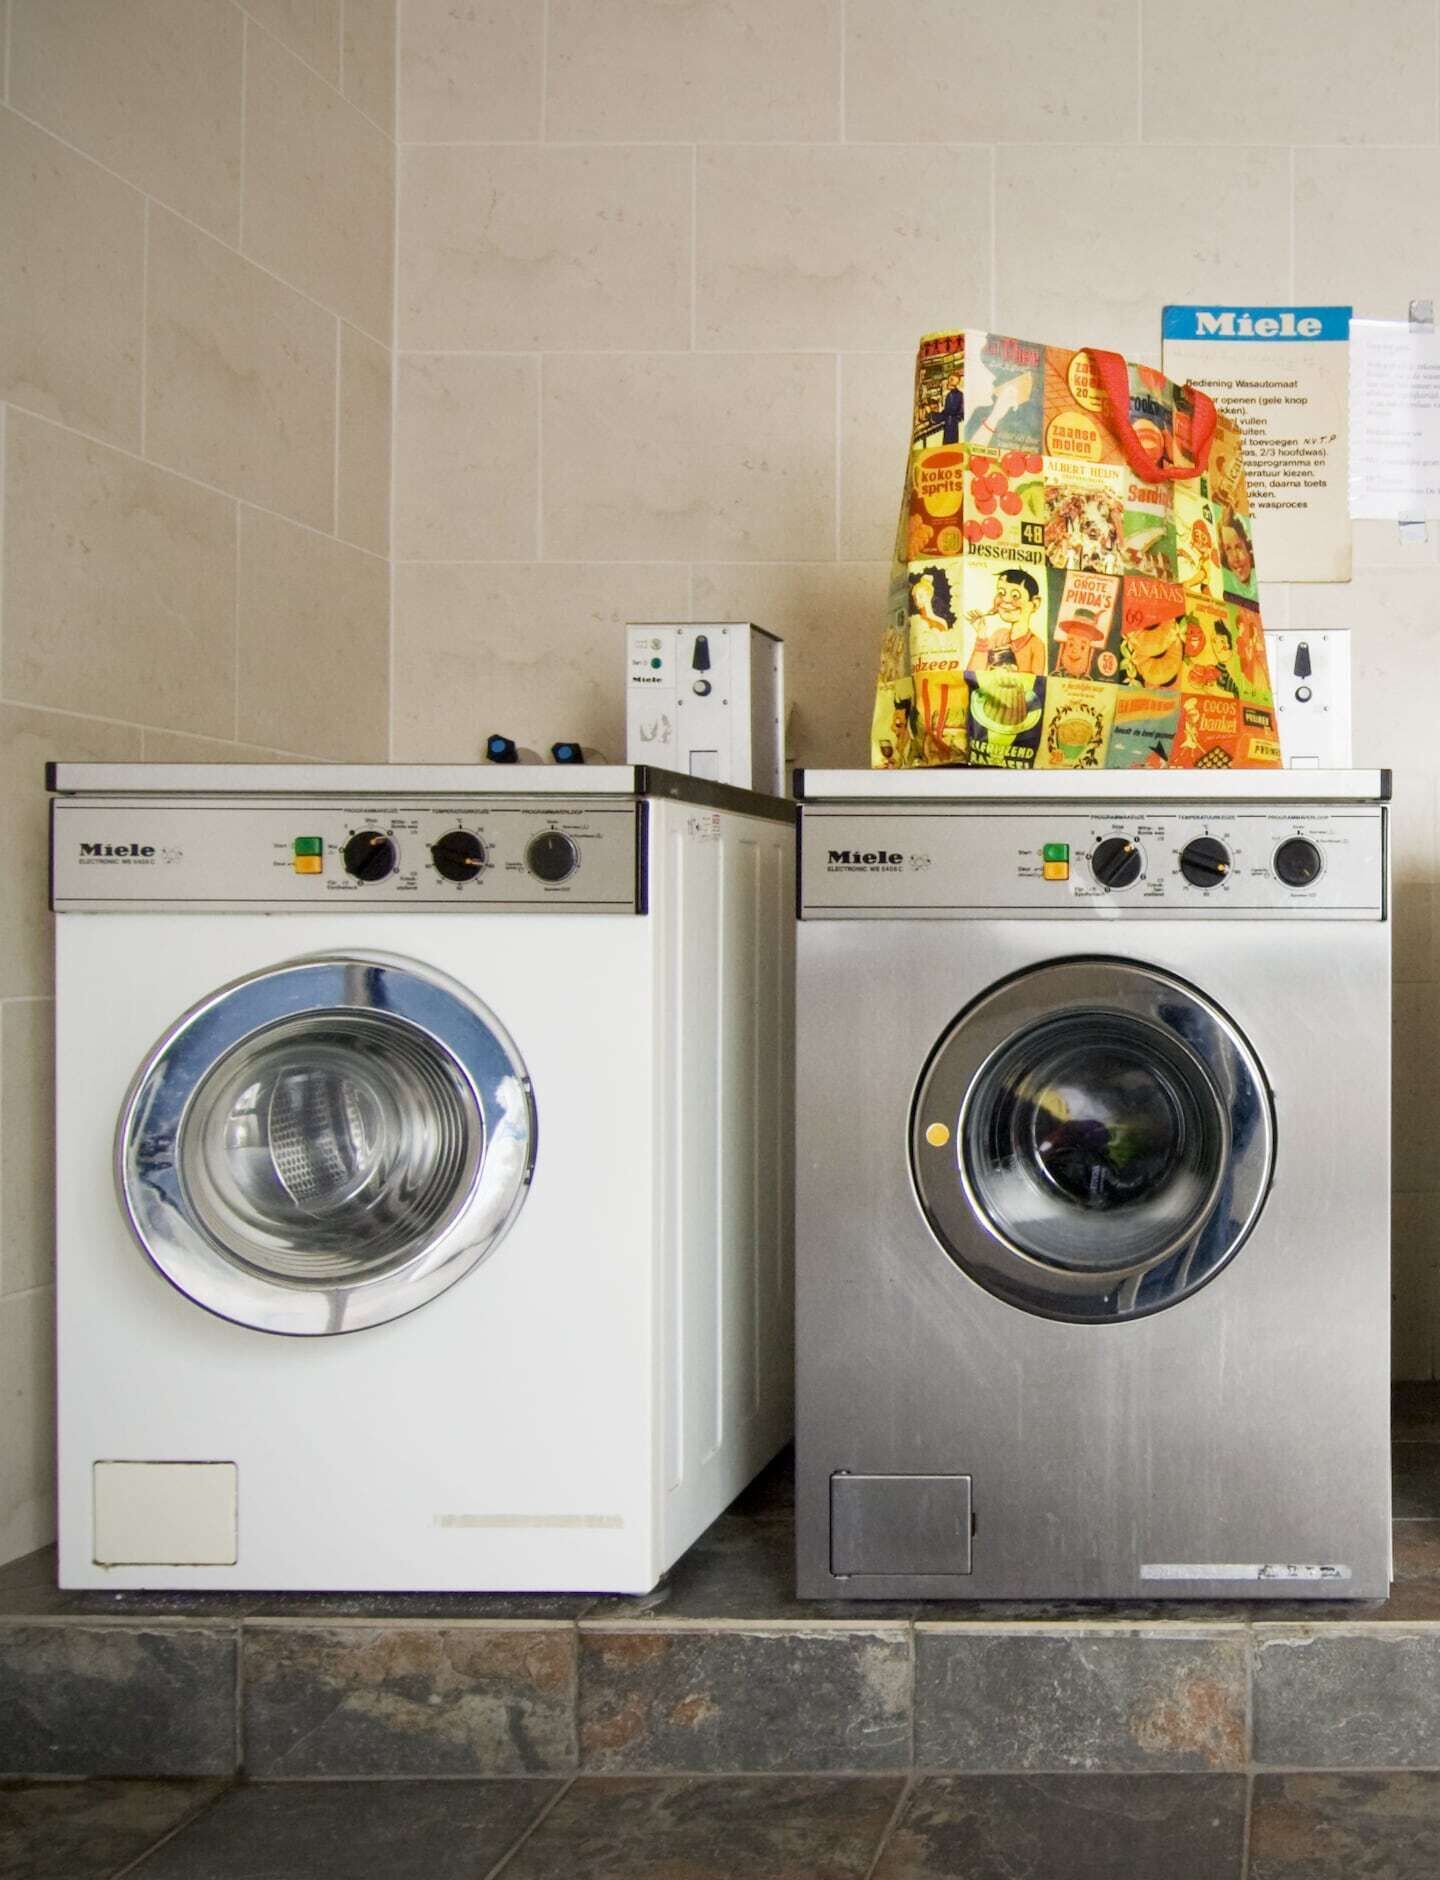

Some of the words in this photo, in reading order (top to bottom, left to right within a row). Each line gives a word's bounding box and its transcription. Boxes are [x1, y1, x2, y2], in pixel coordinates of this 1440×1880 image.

[1195, 311, 1322, 337] Miele
[1186, 379, 1233, 389] Bediening
[1236, 379, 1298, 388] Wasautomaat
[1221, 397, 1257, 405] openen
[1259, 396, 1282, 405] (gele
[1284, 396, 1308, 405] knop
[1240, 417, 1267, 425] vullen
[1052, 425, 1097, 441] zaanse
[1052, 439, 1092, 453] molen
[1249, 438, 1298, 447] toevoegen
[1047, 460, 1085, 474] ALBERT
[1283, 469, 1315, 477] kiezen.
[921, 469, 963, 482] kokos
[921, 481, 963, 496] sprits
[1258, 501, 1308, 509] wasproces
[1023, 525, 1043, 543] 48
[968, 537, 1043, 565] bessensap
[1073, 580, 1107, 592] GROTE
[1127, 581, 1184, 603] ANANAS
[1066, 590, 1112, 608] PINDA'S
[1203, 699, 1237, 715] COCOS
[1200, 714, 1237, 733] banket
[80, 843, 155, 857] Miele
[827, 850, 903, 864] Miele
